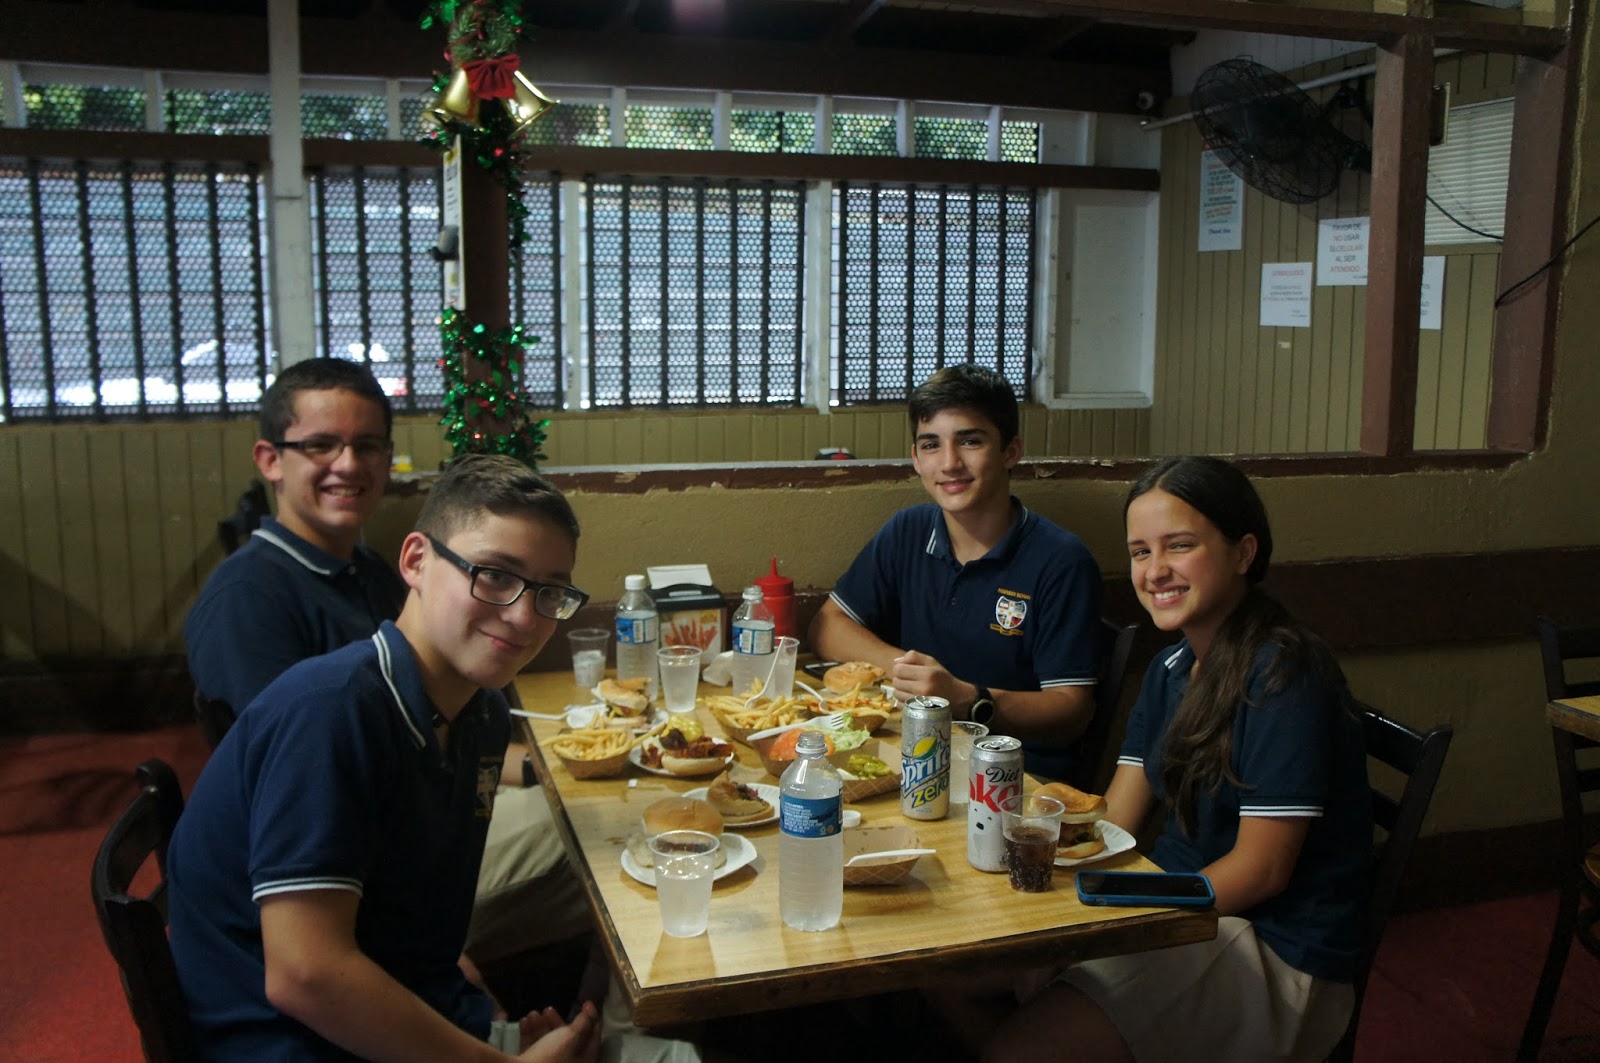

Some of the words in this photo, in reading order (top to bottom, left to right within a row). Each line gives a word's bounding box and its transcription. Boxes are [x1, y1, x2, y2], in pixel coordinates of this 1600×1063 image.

[1343, 233, 1360, 241] USAR
[900, 740, 950, 792] Sprite
[985, 766, 1020, 783] Diet
[911, 771, 950, 808] zero
